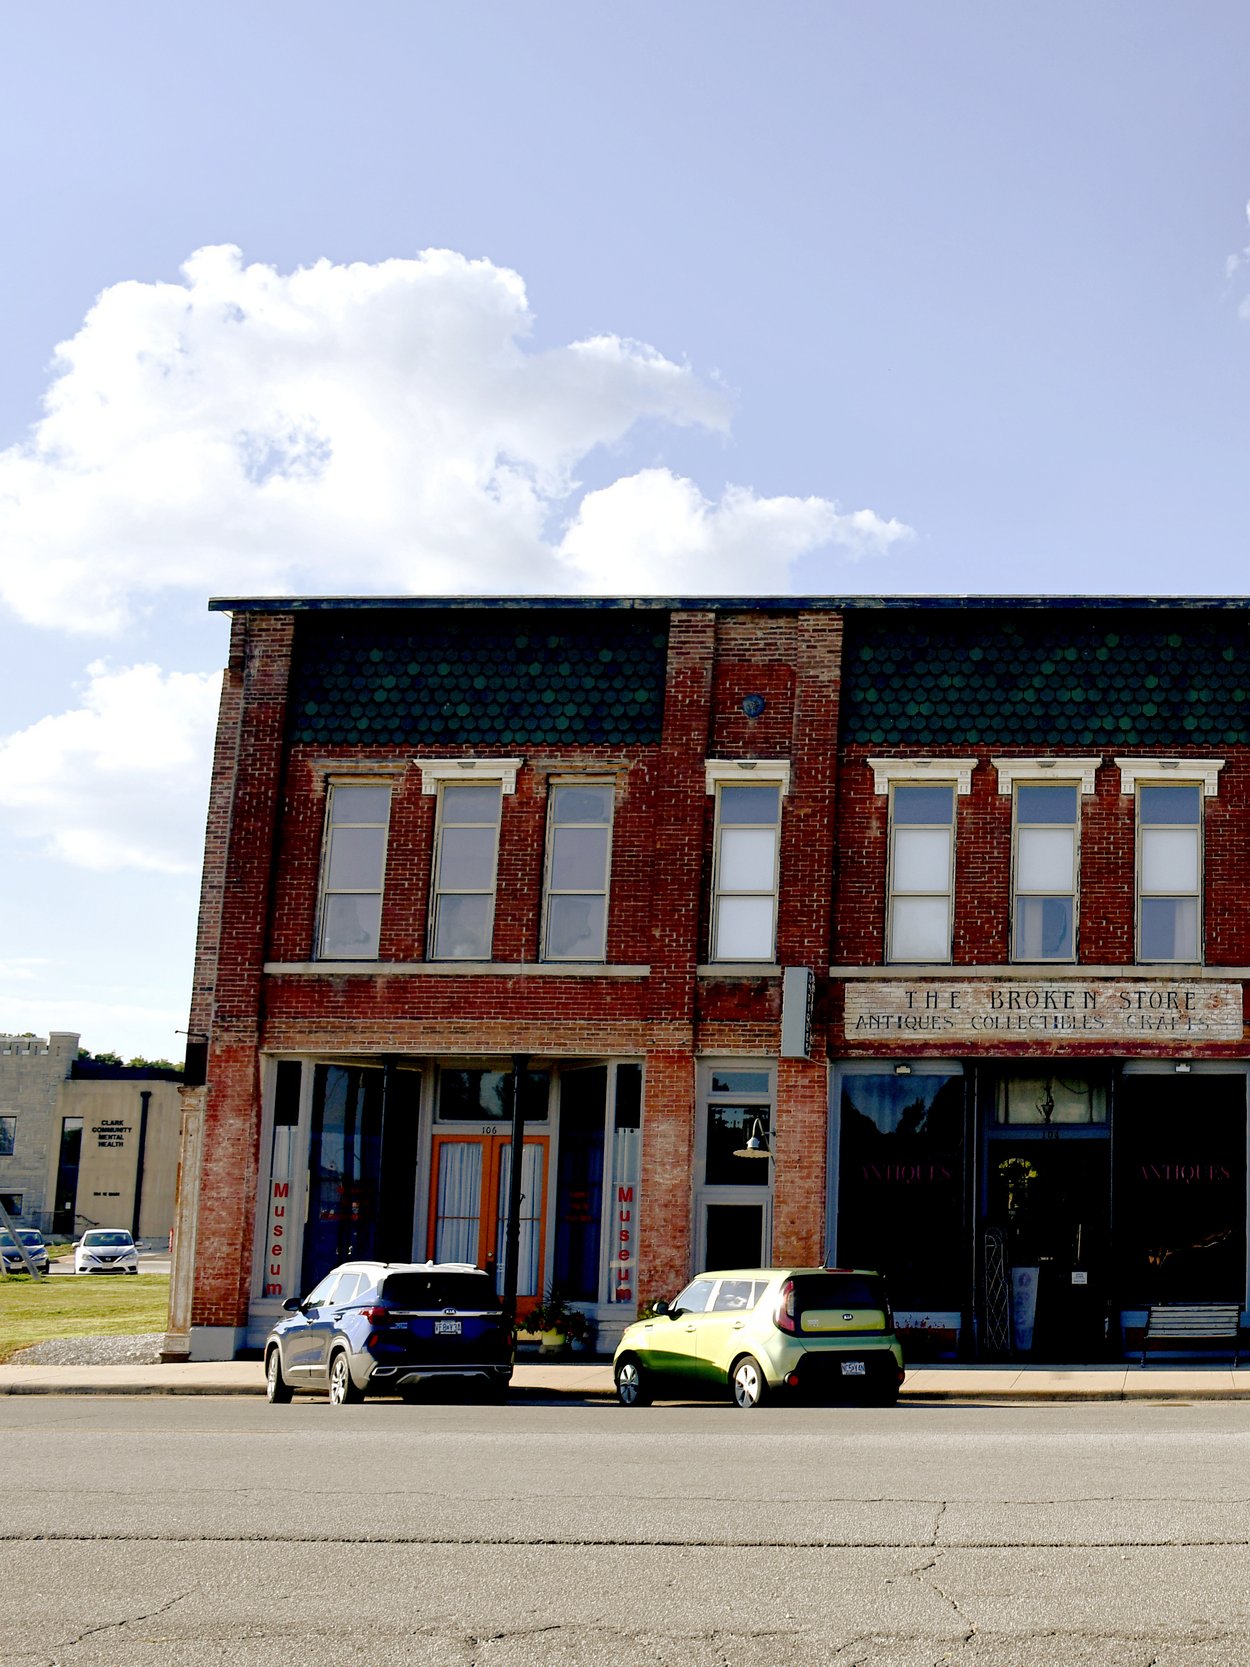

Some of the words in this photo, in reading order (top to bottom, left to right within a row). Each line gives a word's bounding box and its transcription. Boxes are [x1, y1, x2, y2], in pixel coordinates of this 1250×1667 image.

[905, 991, 961, 1009] THE
[990, 990, 1097, 1010] BROKEN
[855, 1015, 954, 1031] ANTIQUES
[971, 1015, 1105, 1031] COLLECTIBLES
[482, 1126, 497, 1135] 106
[266, 1183, 289, 1296] Museum
[615, 1186, 633, 1301] Museum
